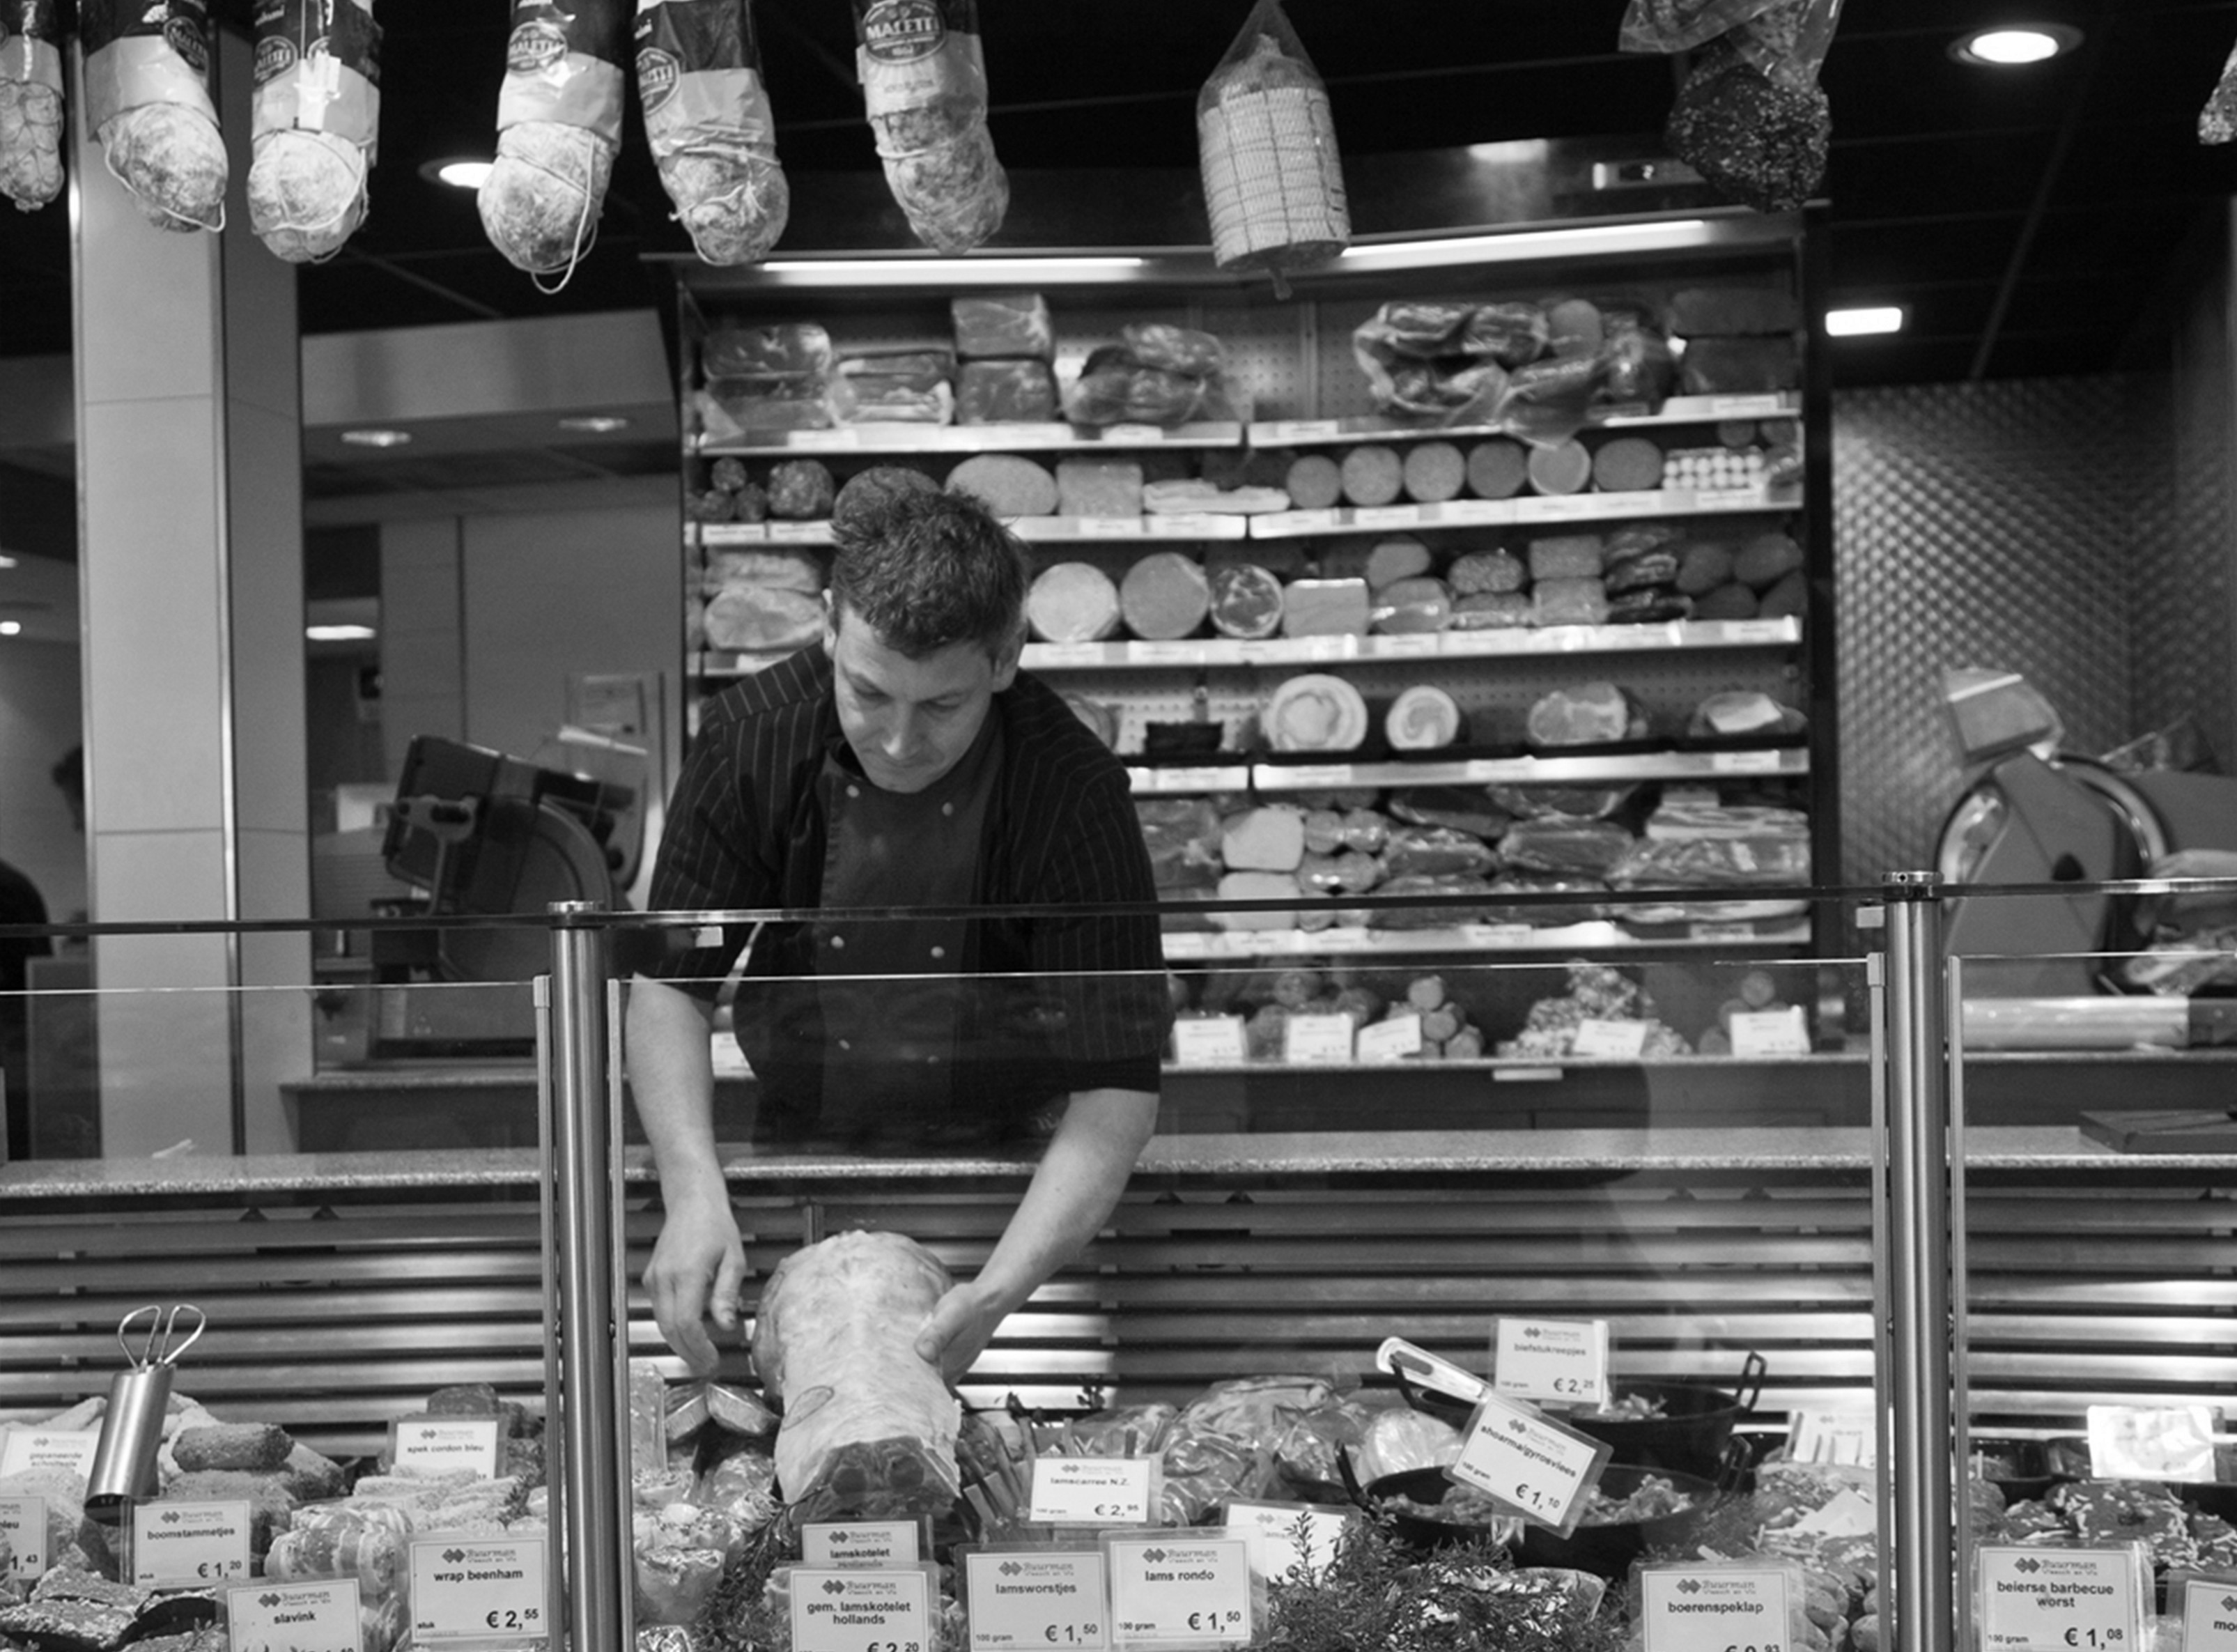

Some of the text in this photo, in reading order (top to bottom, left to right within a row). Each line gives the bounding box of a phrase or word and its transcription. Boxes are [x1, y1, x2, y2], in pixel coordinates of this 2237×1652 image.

[1514, 1343, 1586, 1356] biefstukreepjes
[1553, 1377, 1563, 1392] €
[408, 1445, 428, 1454] spek
[431, 1444, 463, 1453] cordon
[1051, 1477, 1108, 1485] lamscarree
[1515, 1483, 1528, 1499] €
[1094, 1504, 1106, 1516] €
[147, 1527, 235, 1540] boomstammetjes
[830, 1548, 891, 1559] lamskotelet
[10, 1554, 38, 1573] 1,43
[197, 1559, 242, 1580] € 1,20
[433, 1568, 524, 1584] wrap beenham
[1145, 1570, 1215, 1582] lams rondo
[996, 1582, 1077, 1596] lamsworstjes
[1997, 1580, 2114, 1595] beierse barbecue
[807, 1602, 911, 1615] gem. lamskotelet
[1668, 1601, 1765, 1614] boerenspeklap
[2036, 1597, 2075, 1608] worst
[273, 1611, 316, 1625] slavink
[486, 1608, 539, 1631] € 2,55
[833, 1614, 885, 1625] hollands
[1188, 1610, 1241, 1632] € 1,50
[1134, 1622, 1156, 1632] gram
[2213, 1620, 2237, 1632] mo
[992, 1635, 1013, 1643] gram
[1045, 1623, 1099, 1644] € 1,50
[2005, 1635, 2029, 1644] gram
[2064, 1628, 2123, 1651] € 1,08
